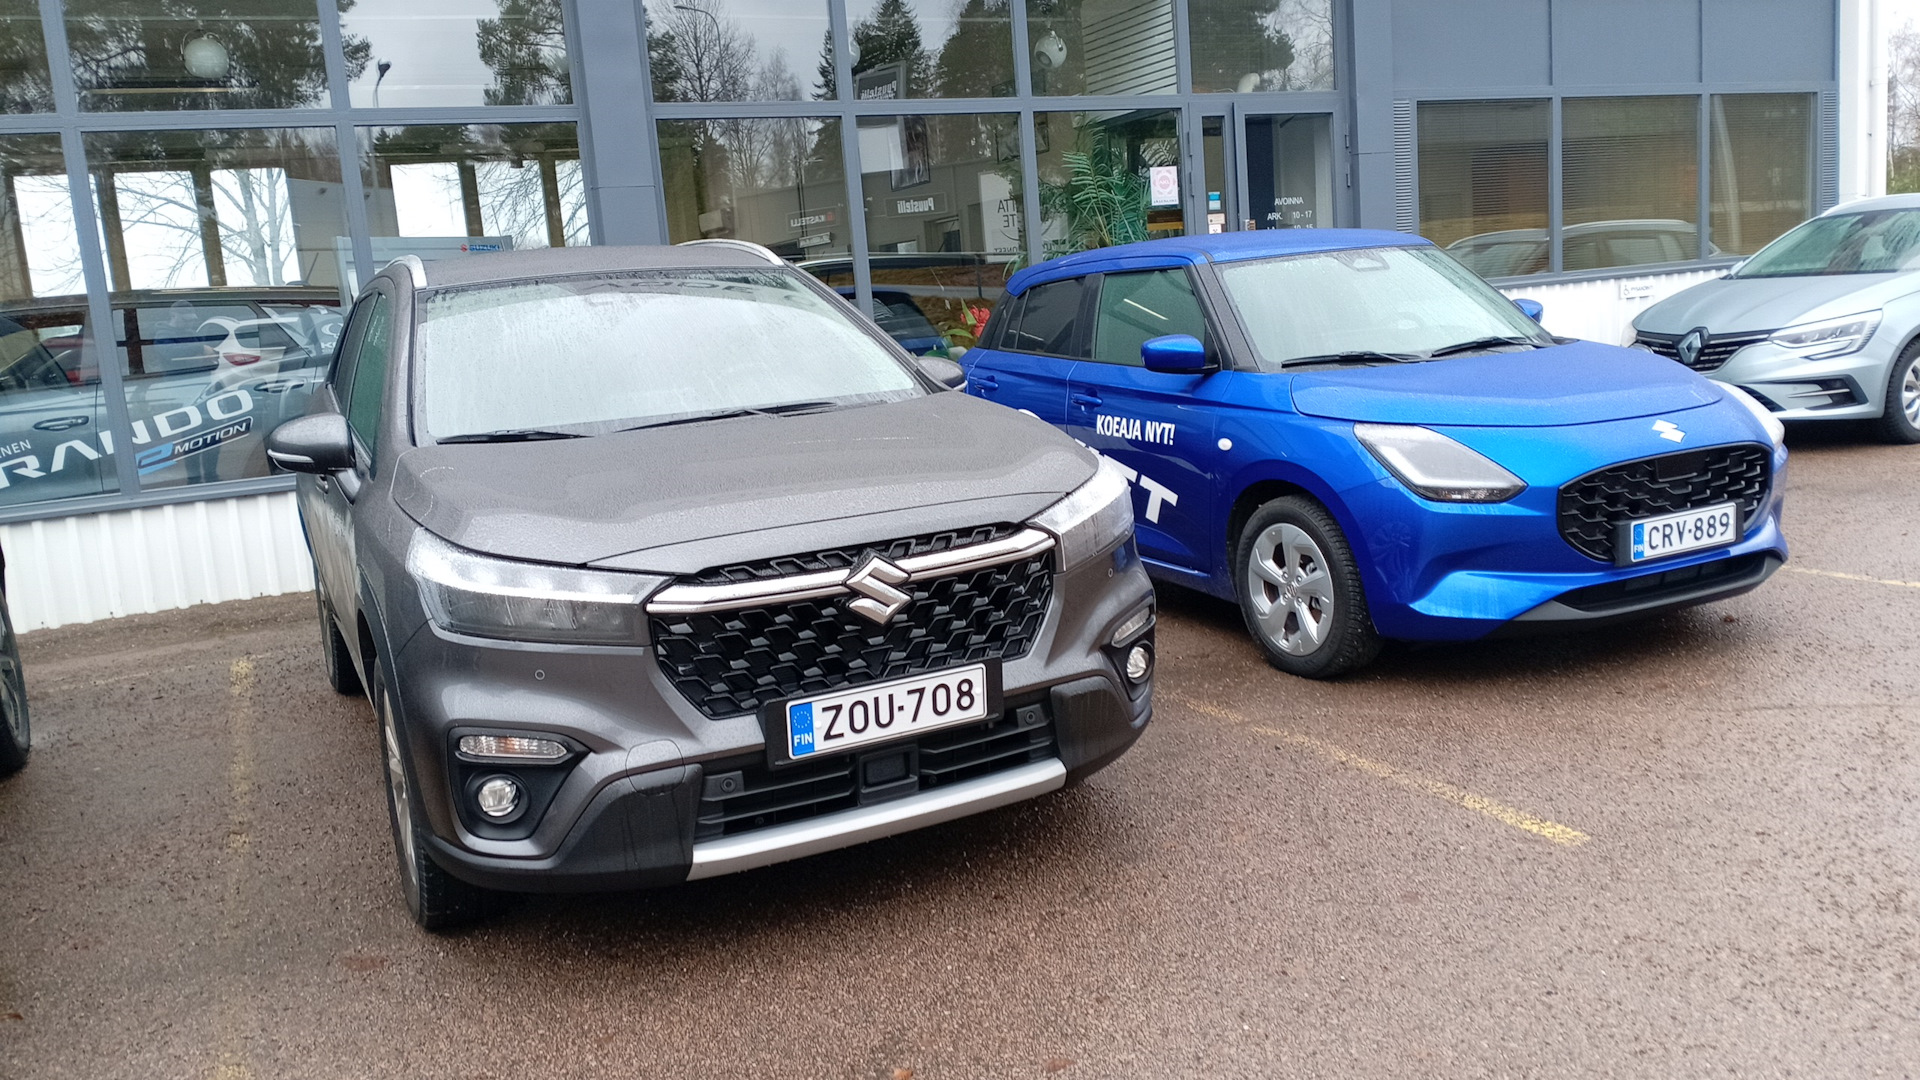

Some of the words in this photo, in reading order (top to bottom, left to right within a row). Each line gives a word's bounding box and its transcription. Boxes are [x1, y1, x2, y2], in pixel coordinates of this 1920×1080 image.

[1274, 196, 1304, 206] AVOINNA
[1096, 414, 1142, 441] KOEAJA
[1145, 420, 1176, 446] NYT!
[793, 731, 813, 747] FIN
[821, 678, 975, 742] ZOU-708
